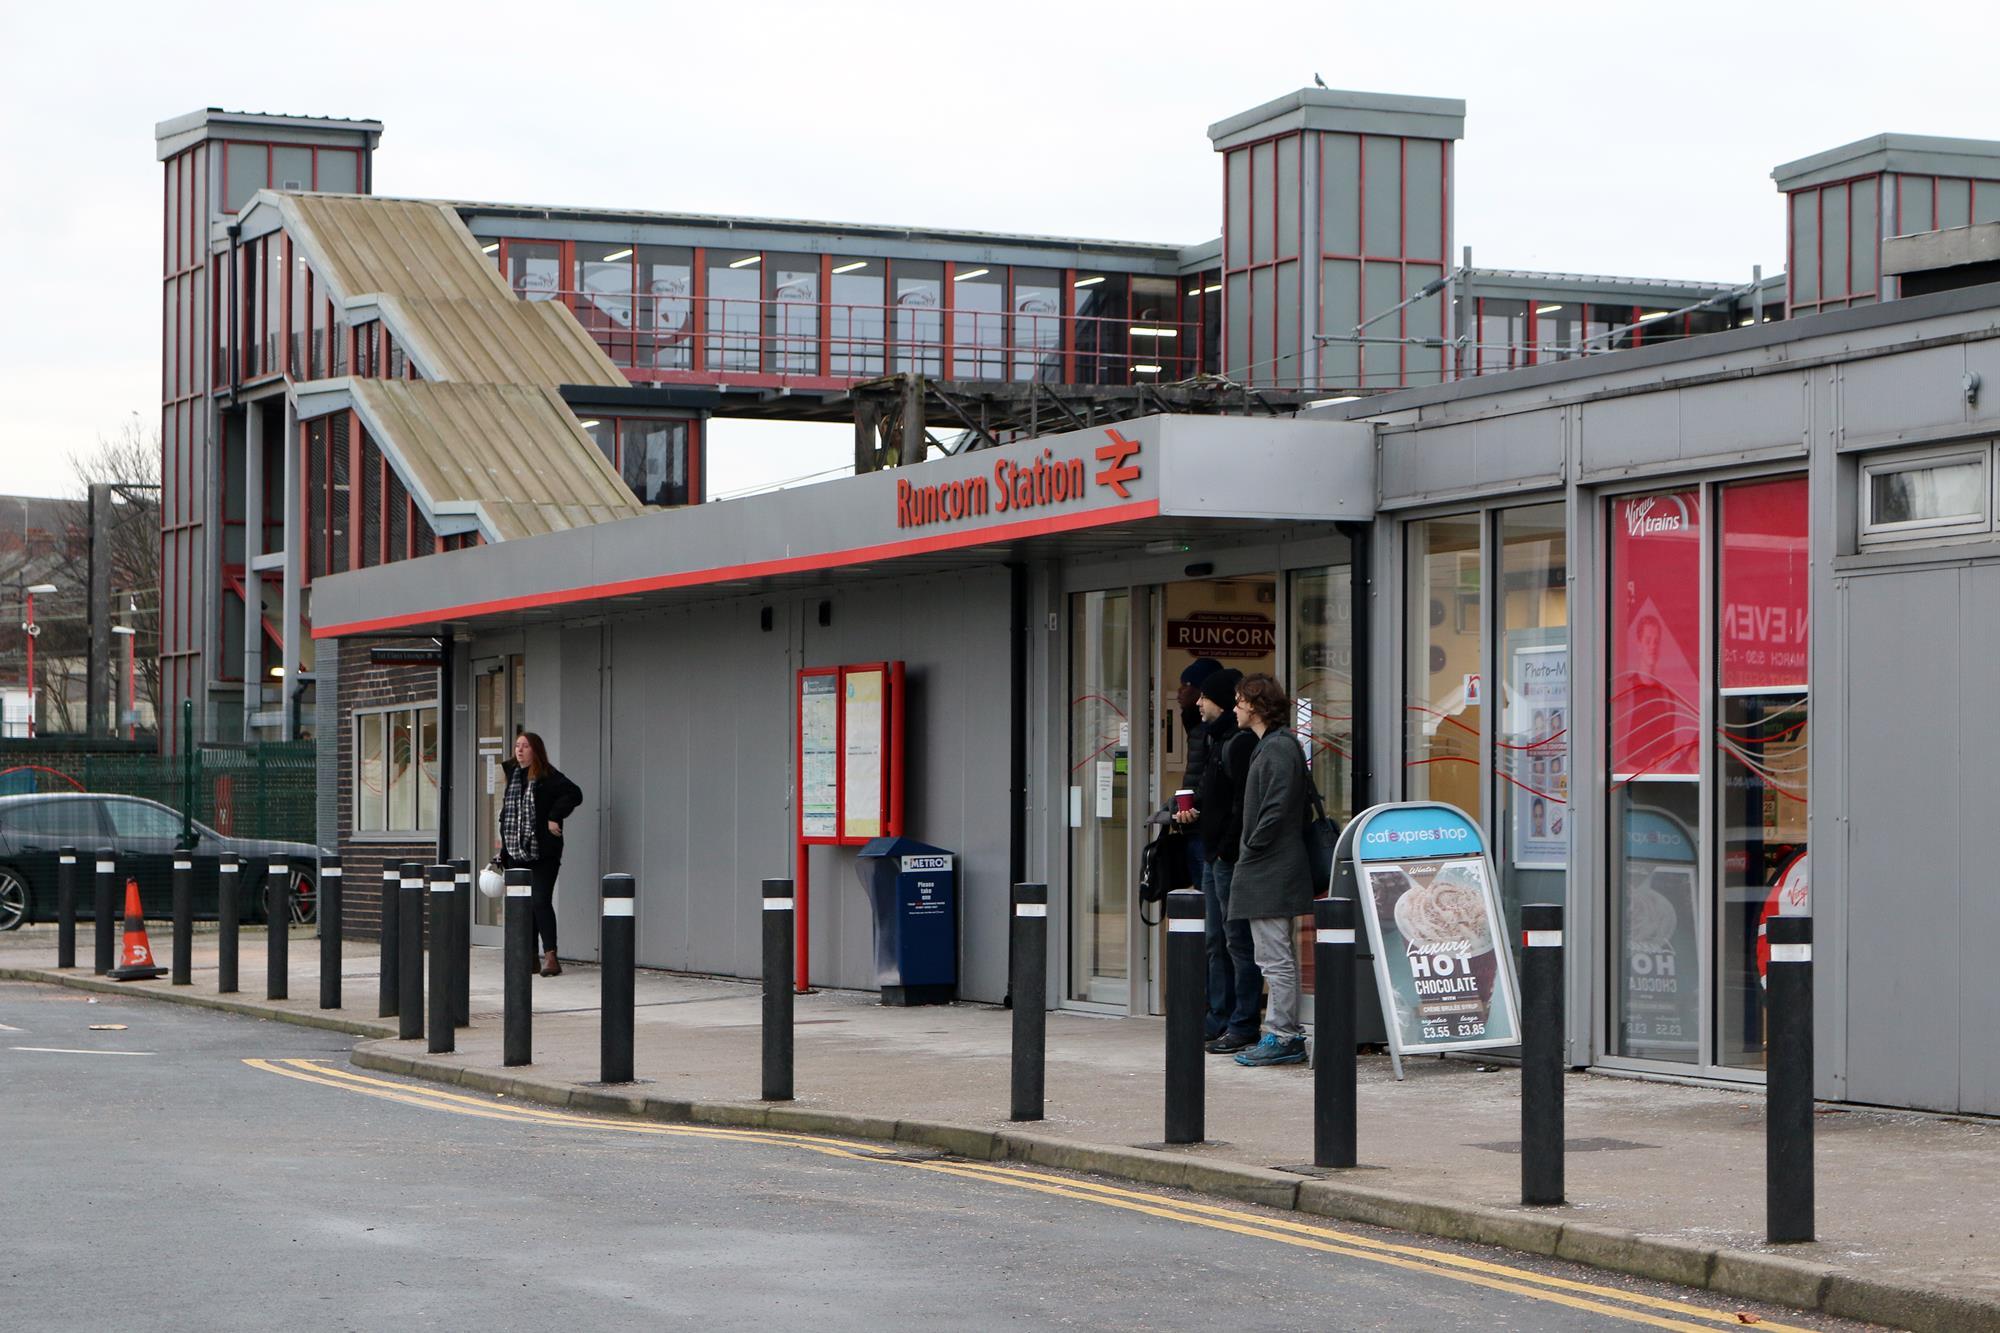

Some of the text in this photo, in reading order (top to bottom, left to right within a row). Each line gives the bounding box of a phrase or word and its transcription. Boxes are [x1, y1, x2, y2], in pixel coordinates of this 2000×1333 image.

[897, 447, 1084, 528] Runcorn Station
[1625, 496, 1656, 537] Virgin
[1645, 513, 1680, 532] trains
[1179, 626, 1276, 646] RUNCORN
[911, 858, 944, 868] METRO
[1406, 938, 1472, 957] Luxury
[1409, 952, 1473, 978] HOT
[1414, 976, 1478, 995] CHOCOLATE
[1423, 1023, 1486, 1039] £3.55 £3.85
